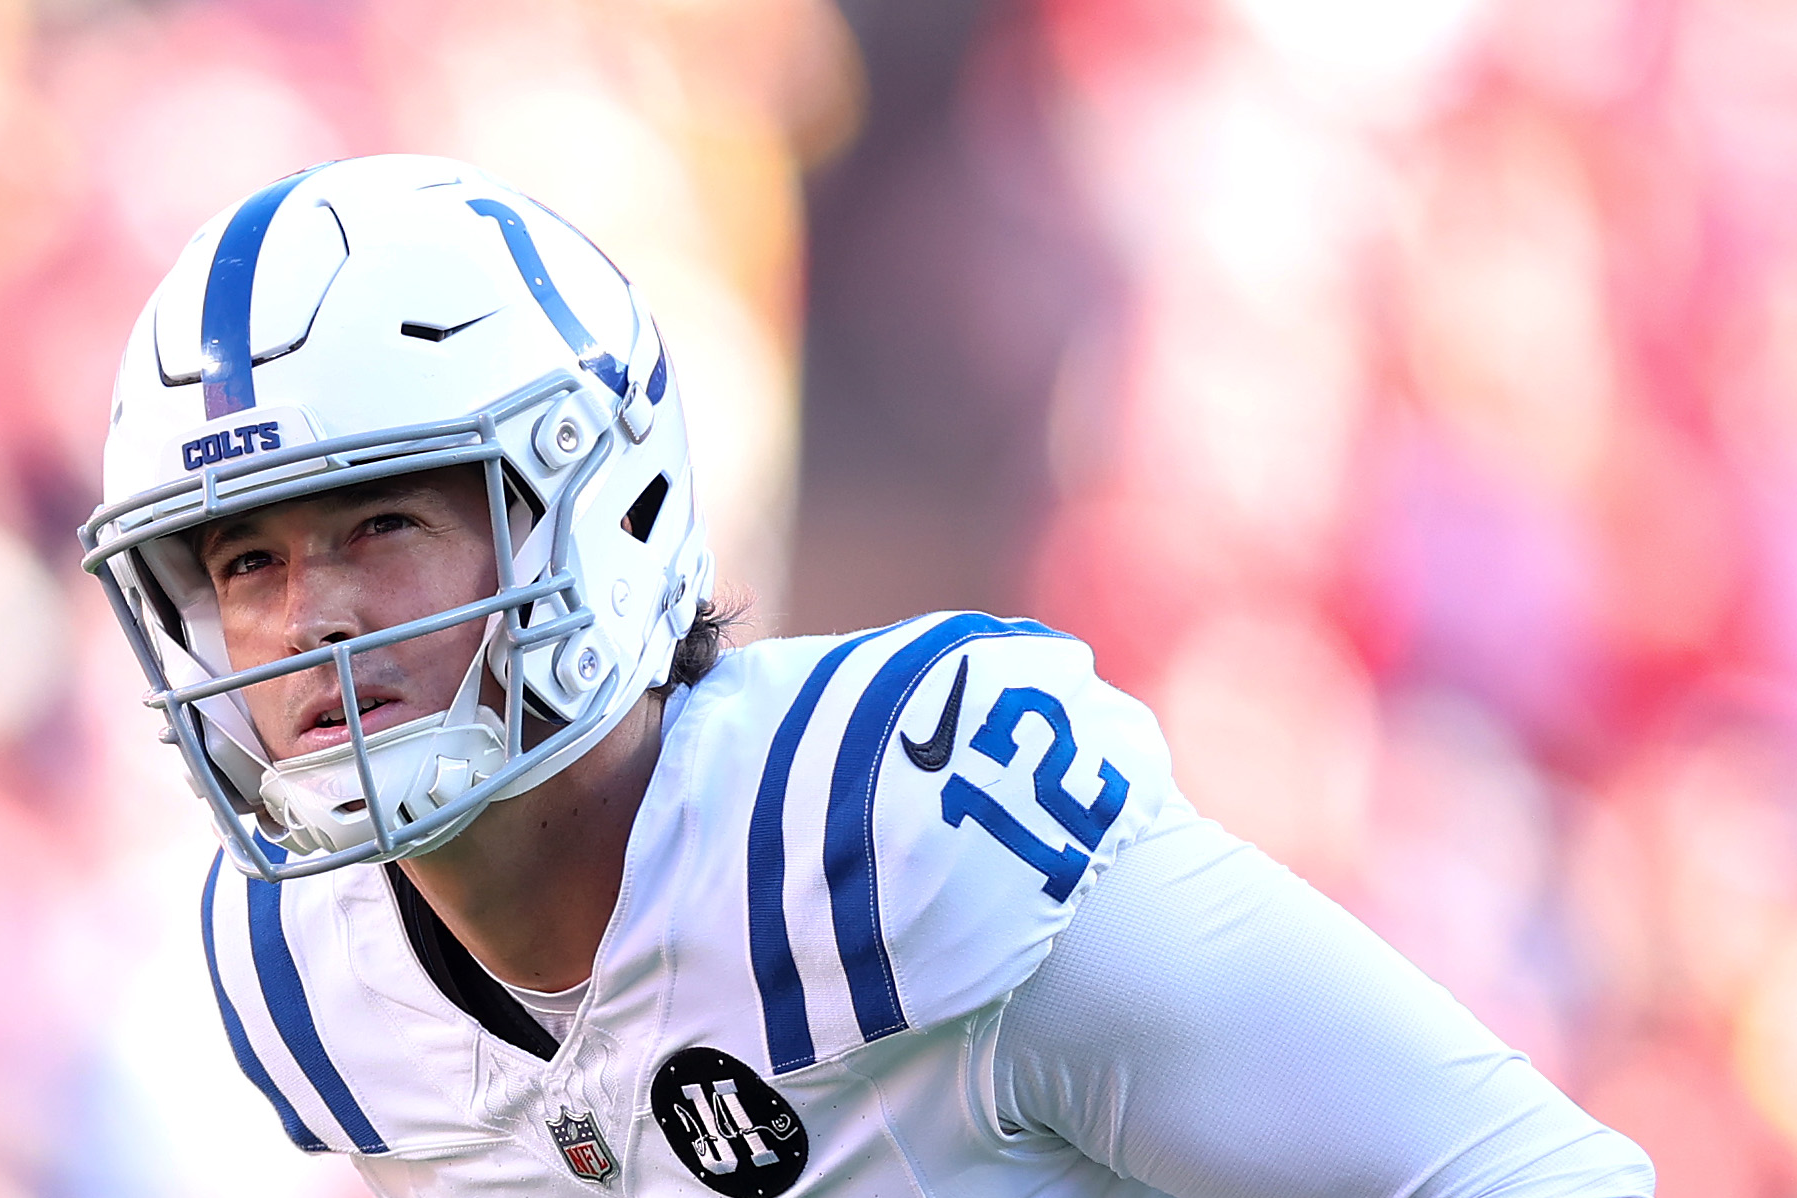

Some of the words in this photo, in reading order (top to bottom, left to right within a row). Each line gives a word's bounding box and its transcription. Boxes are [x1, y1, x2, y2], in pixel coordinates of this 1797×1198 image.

[182, 421, 281, 470] COLTS
[940, 686, 1130, 904] 12
[563, 1142, 608, 1176] NFL
